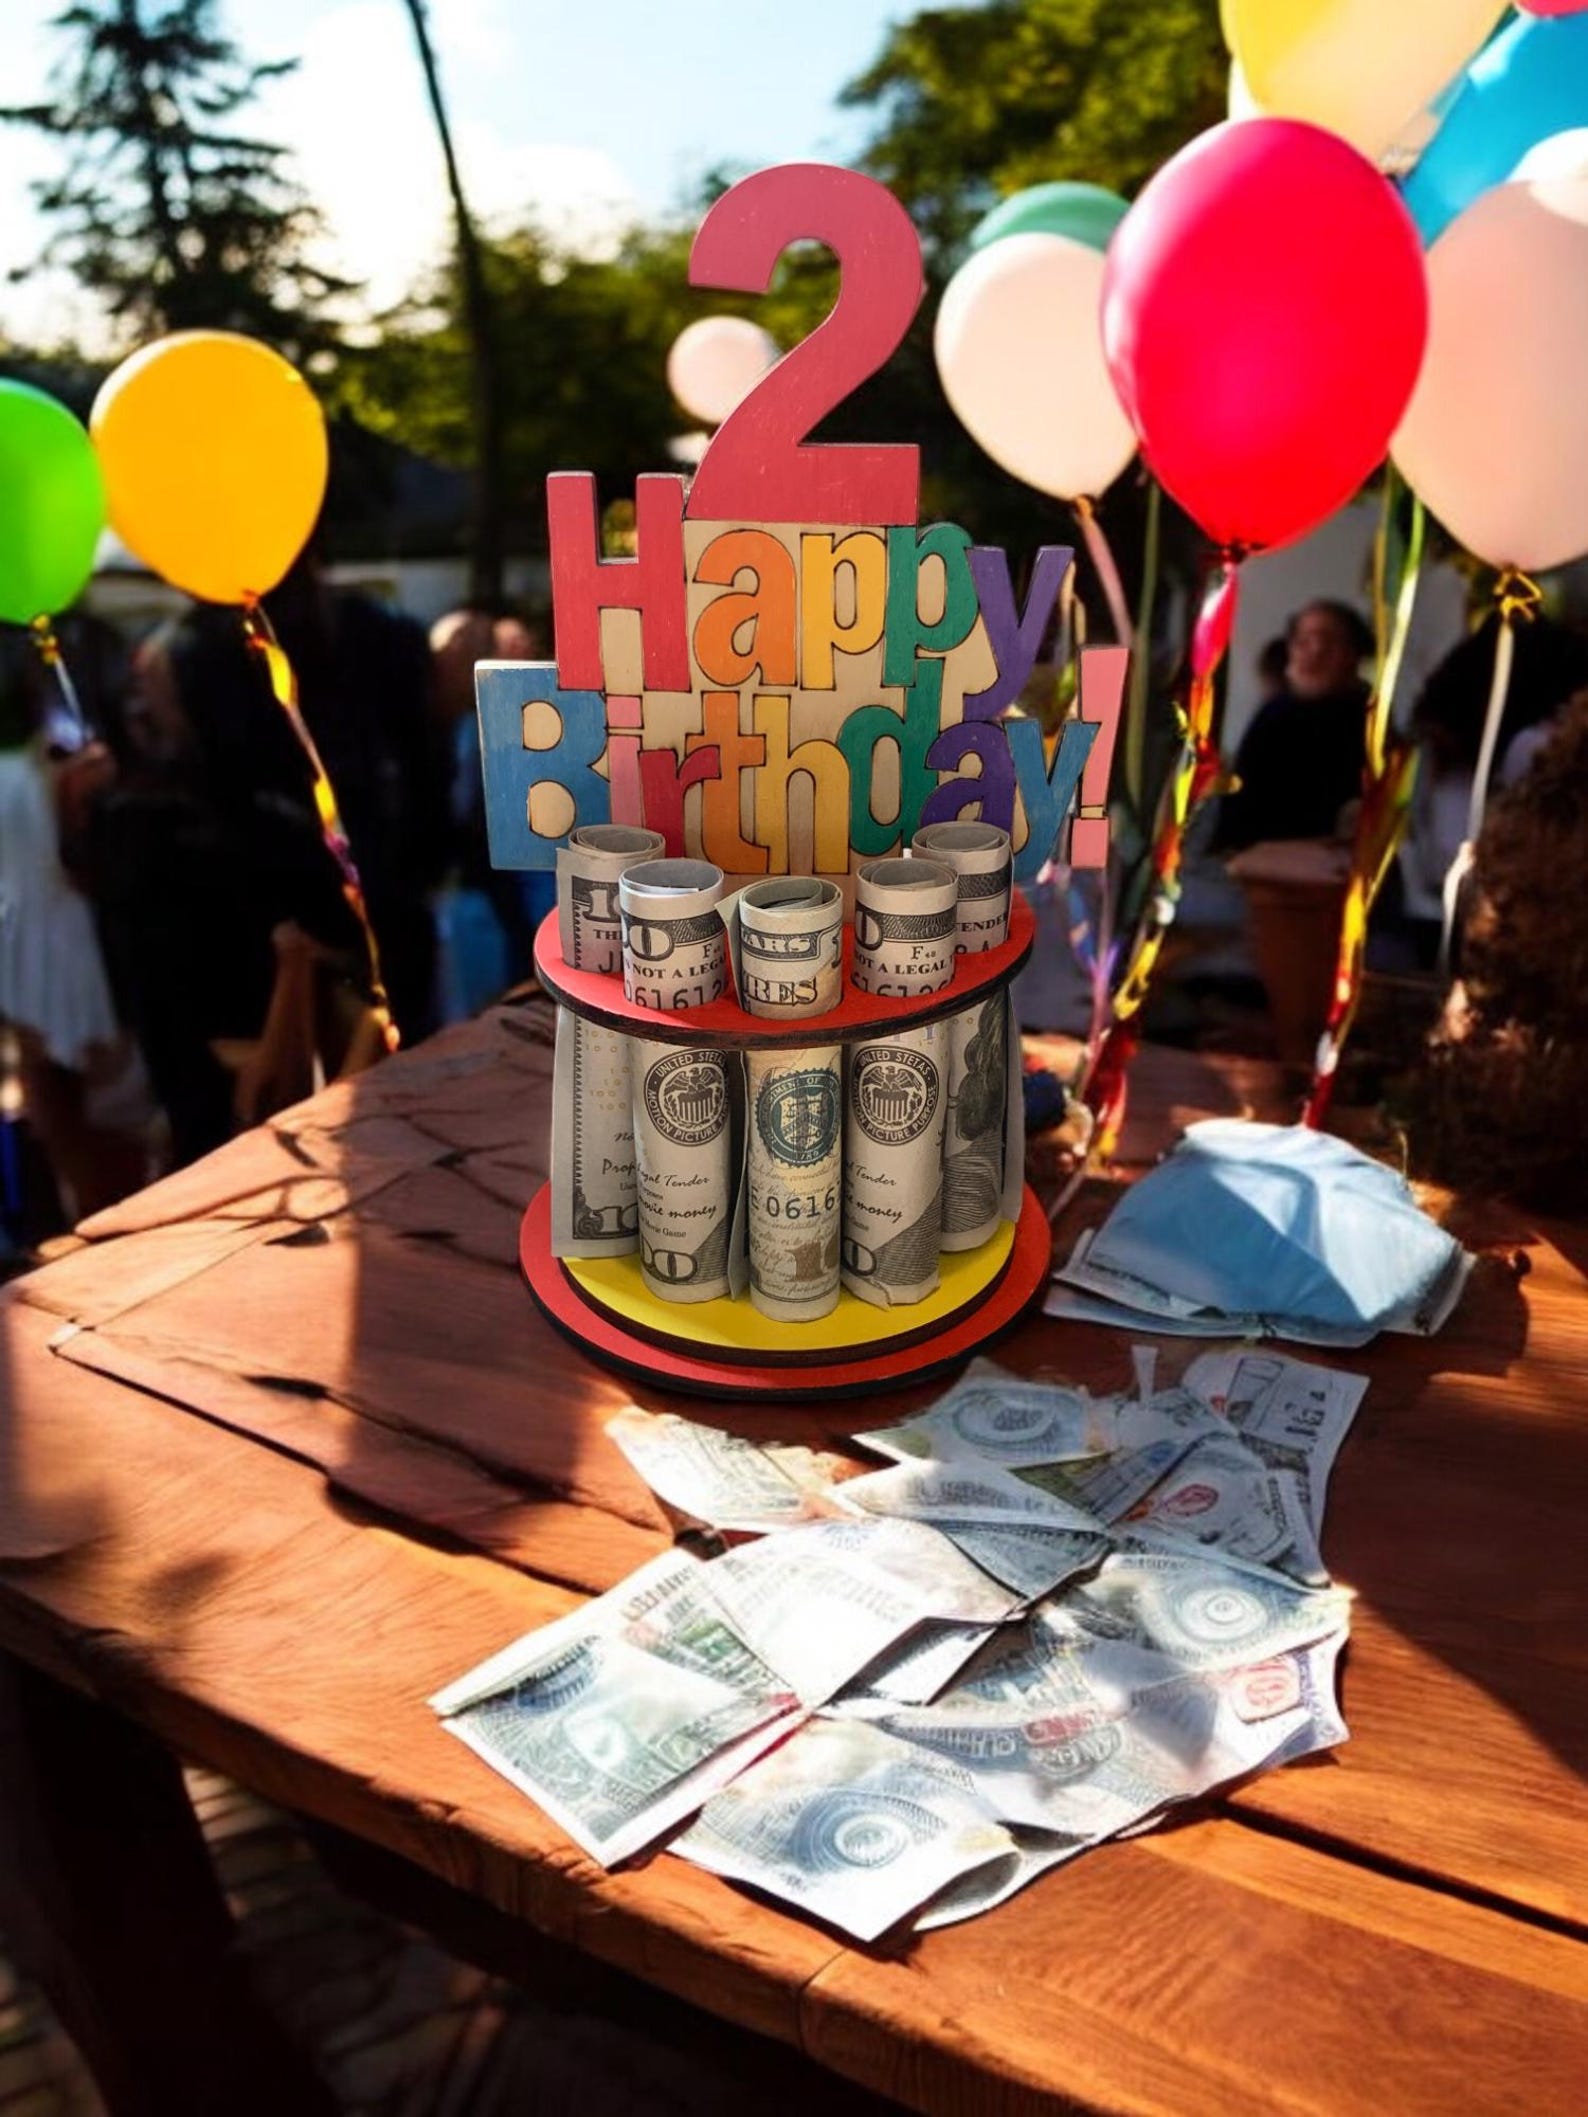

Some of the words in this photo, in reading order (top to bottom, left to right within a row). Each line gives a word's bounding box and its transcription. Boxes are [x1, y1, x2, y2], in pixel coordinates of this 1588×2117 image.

[683, 162, 925, 526] 2
[547, 470, 1075, 720] Happy
[474, 644, 1130, 875] Birthday!
[632, 962, 666, 979] NOT
[672, 969, 683, 979] A
[878, 963, 888, 974] A
[895, 959, 947, 975] LEGAL
[895, 1052, 931, 1075] STETAS
[647, 1088, 673, 1134] MOTION
[672, 1122, 719, 1142] PICTURE
[866, 1122, 910, 1141] PICTURE
[664, 1174, 709, 1188] Tender
[856, 1164, 897, 1186] Tender
[668, 1204, 717, 1220] money
[856, 1201, 904, 1225] money
